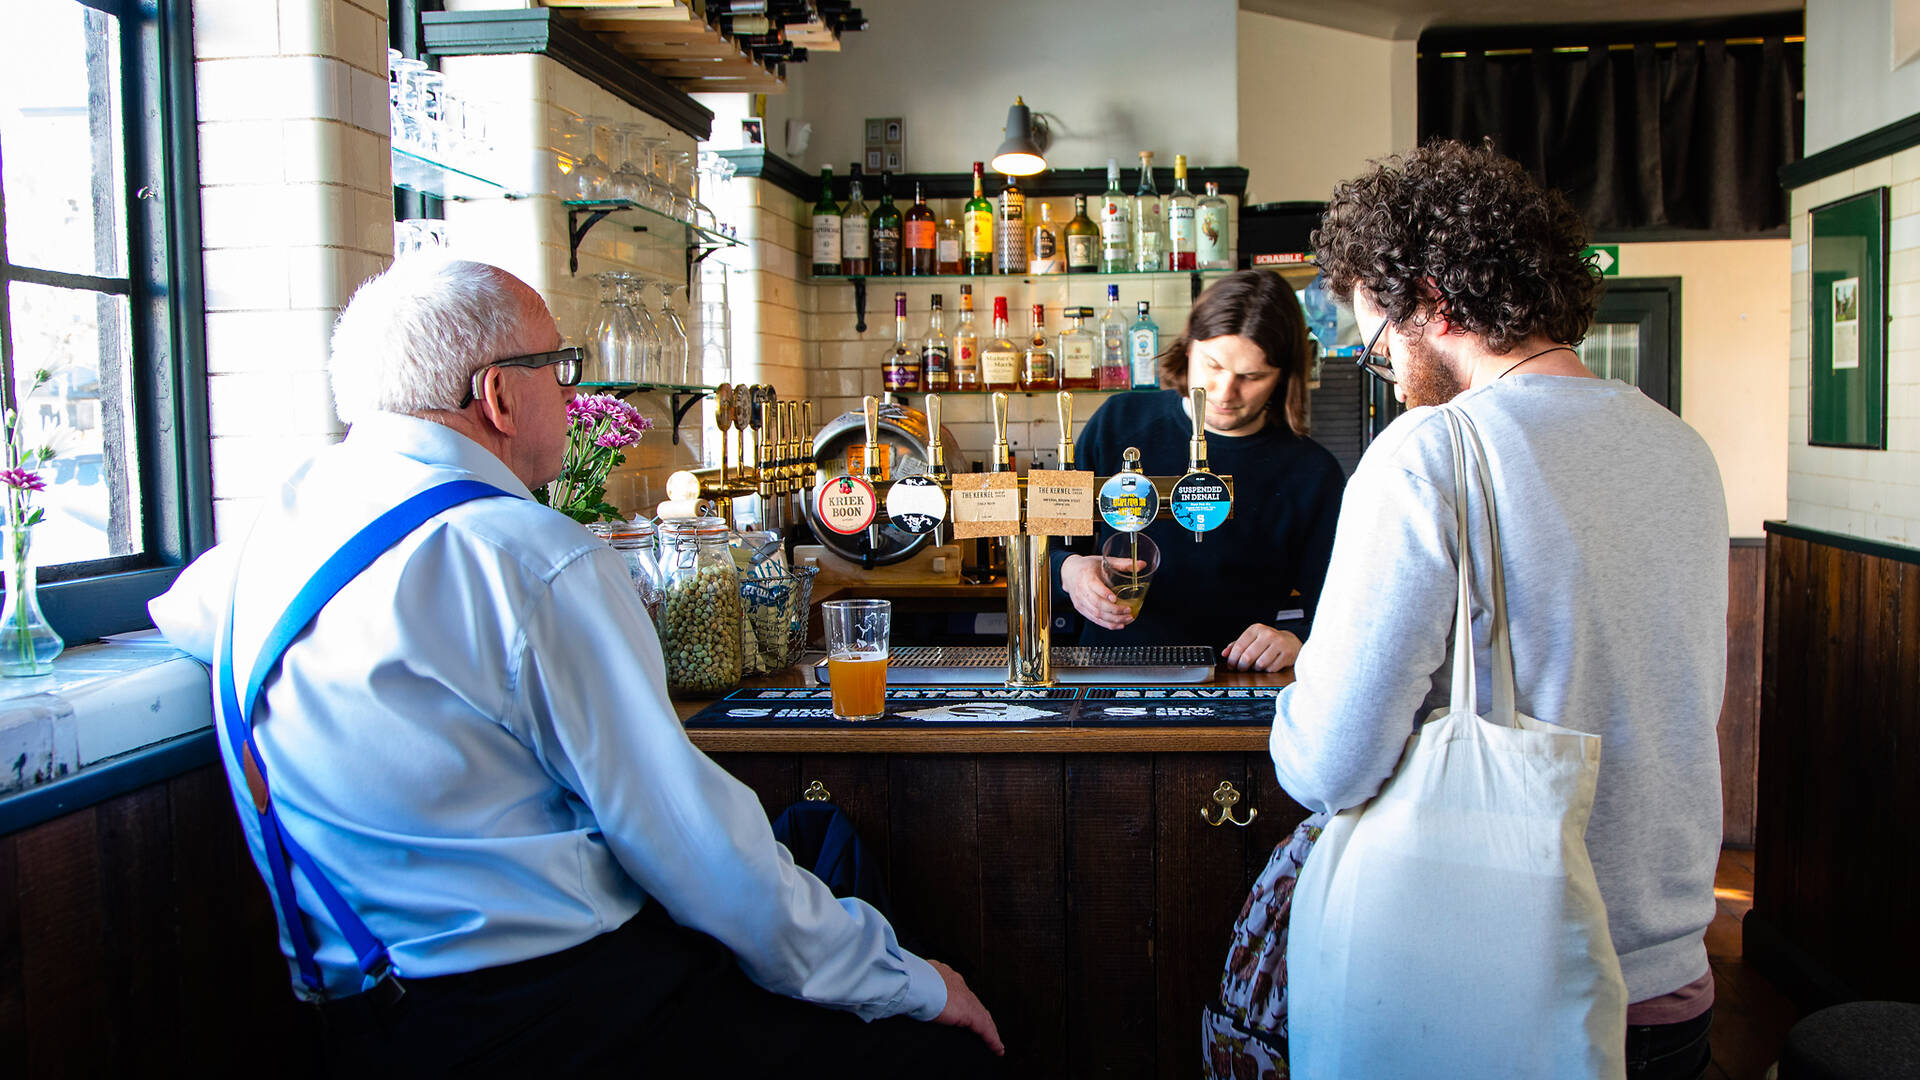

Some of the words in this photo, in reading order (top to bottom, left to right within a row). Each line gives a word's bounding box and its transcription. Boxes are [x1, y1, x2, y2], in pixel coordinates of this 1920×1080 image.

[1256, 253, 1303, 264] SCRABBLE
[1178, 486, 1222, 494] SUSPENDED
[828, 496, 865, 506] KRIEK
[1191, 493, 1220, 501] DENALI
[832, 507, 861, 517] BOON
[757, 690, 1050, 698] BEARTOWN
